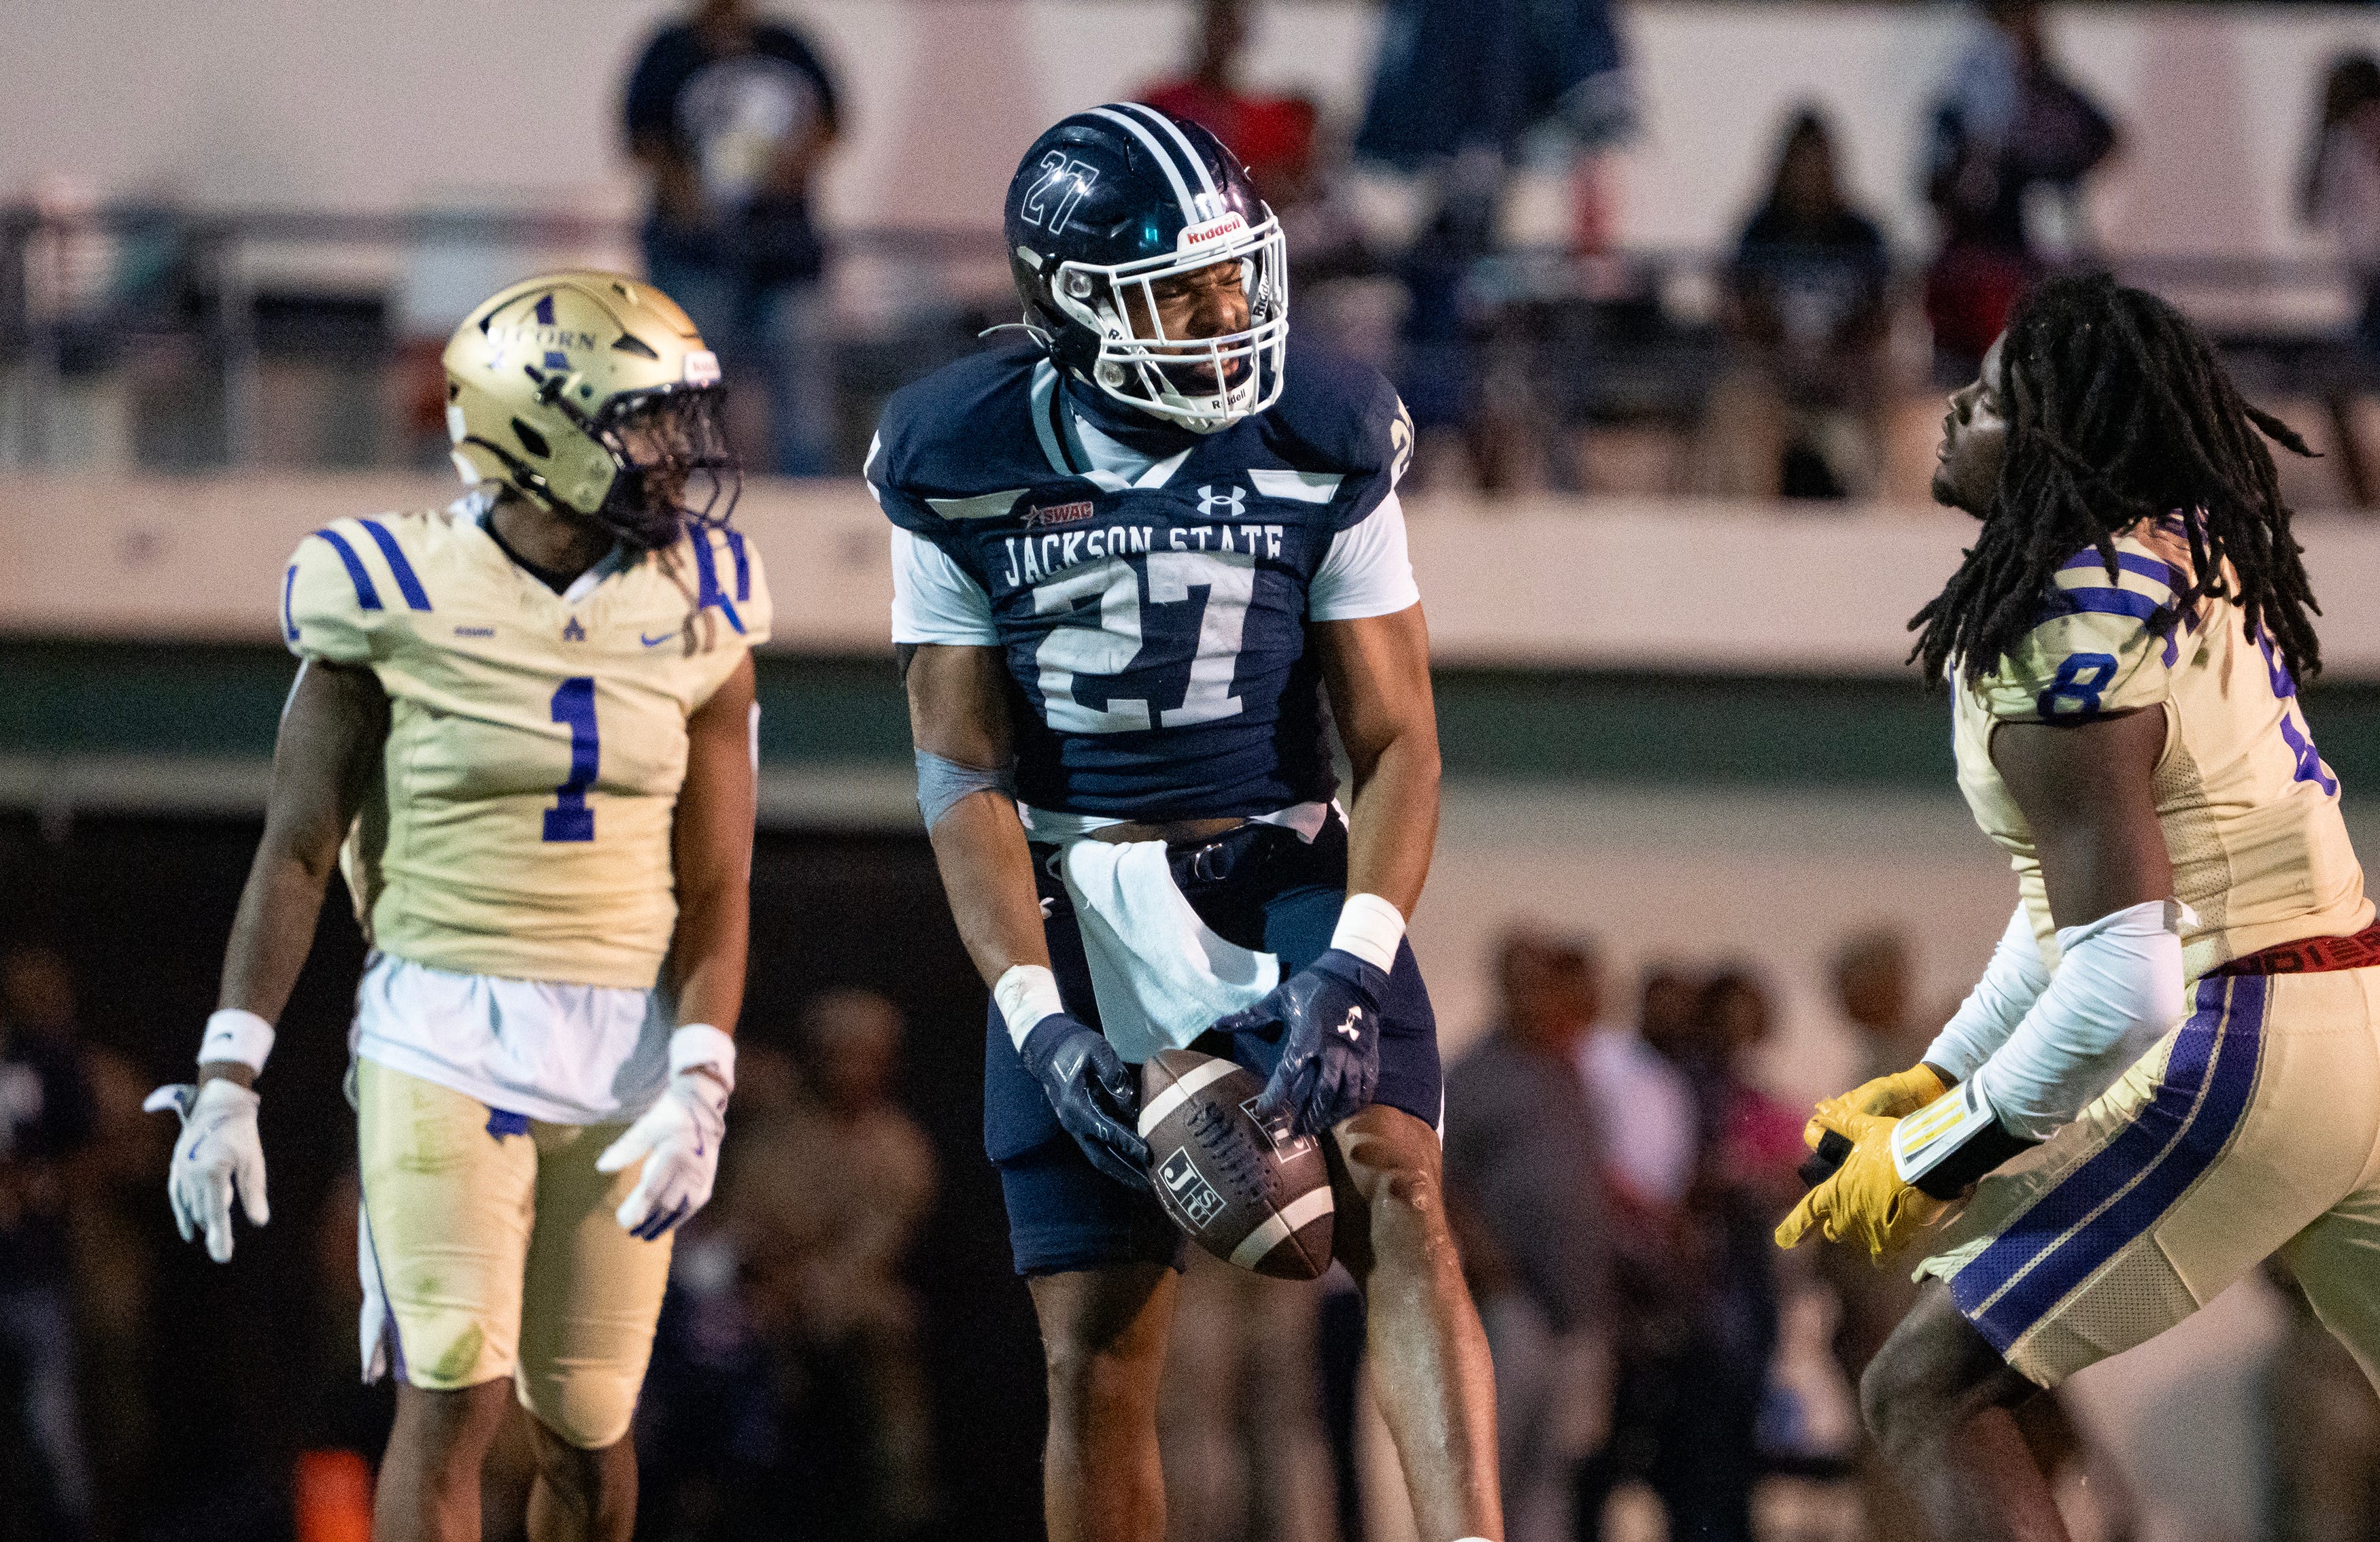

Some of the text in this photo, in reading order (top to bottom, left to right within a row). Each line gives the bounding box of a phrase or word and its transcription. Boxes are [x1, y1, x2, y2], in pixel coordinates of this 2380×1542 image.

[1021, 149, 1100, 235] 27
[1005, 525, 1284, 587] JACKSON STATE
[1034, 551, 1257, 734] 27
[2037, 652, 2119, 726] 8
[542, 676, 599, 842] 1
